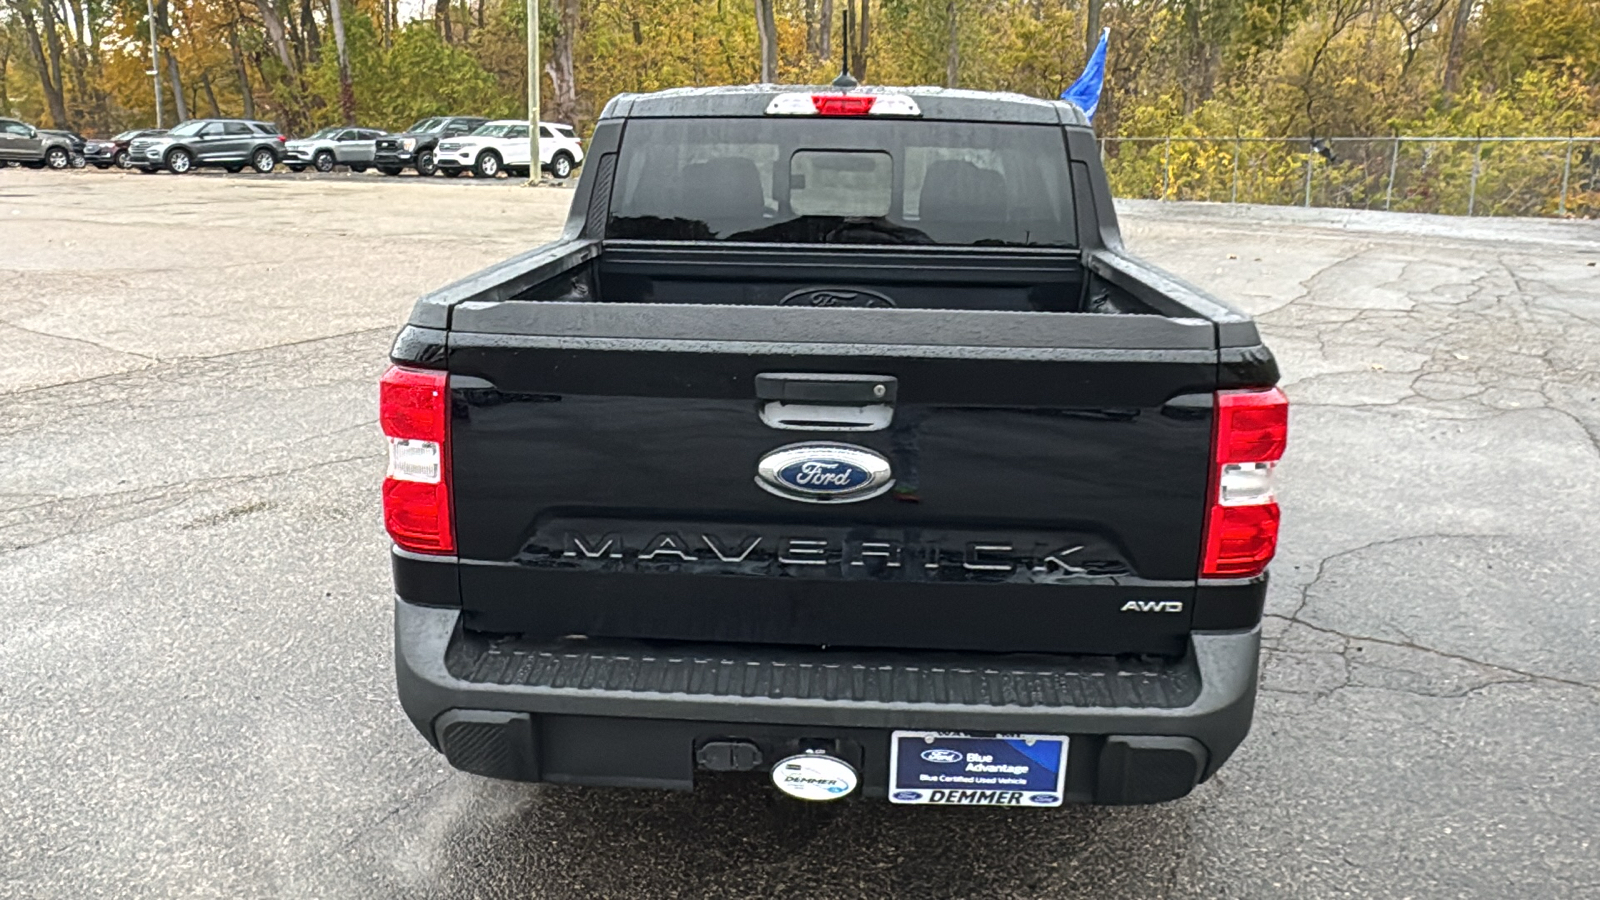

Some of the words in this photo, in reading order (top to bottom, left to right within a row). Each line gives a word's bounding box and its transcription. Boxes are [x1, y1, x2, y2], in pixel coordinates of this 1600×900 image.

[796, 462, 853, 486] Ford
[562, 531, 1087, 573] MAVERICK
[1120, 601, 1183, 612] AWD
[966, 753, 994, 763] Blue
[965, 763, 1029, 774] Advantage
[784, 776, 837, 785] DEMMER
[919, 774, 938, 782] Blue
[939, 775, 974, 783] Certified
[928, 790, 1024, 804] DEMMER
